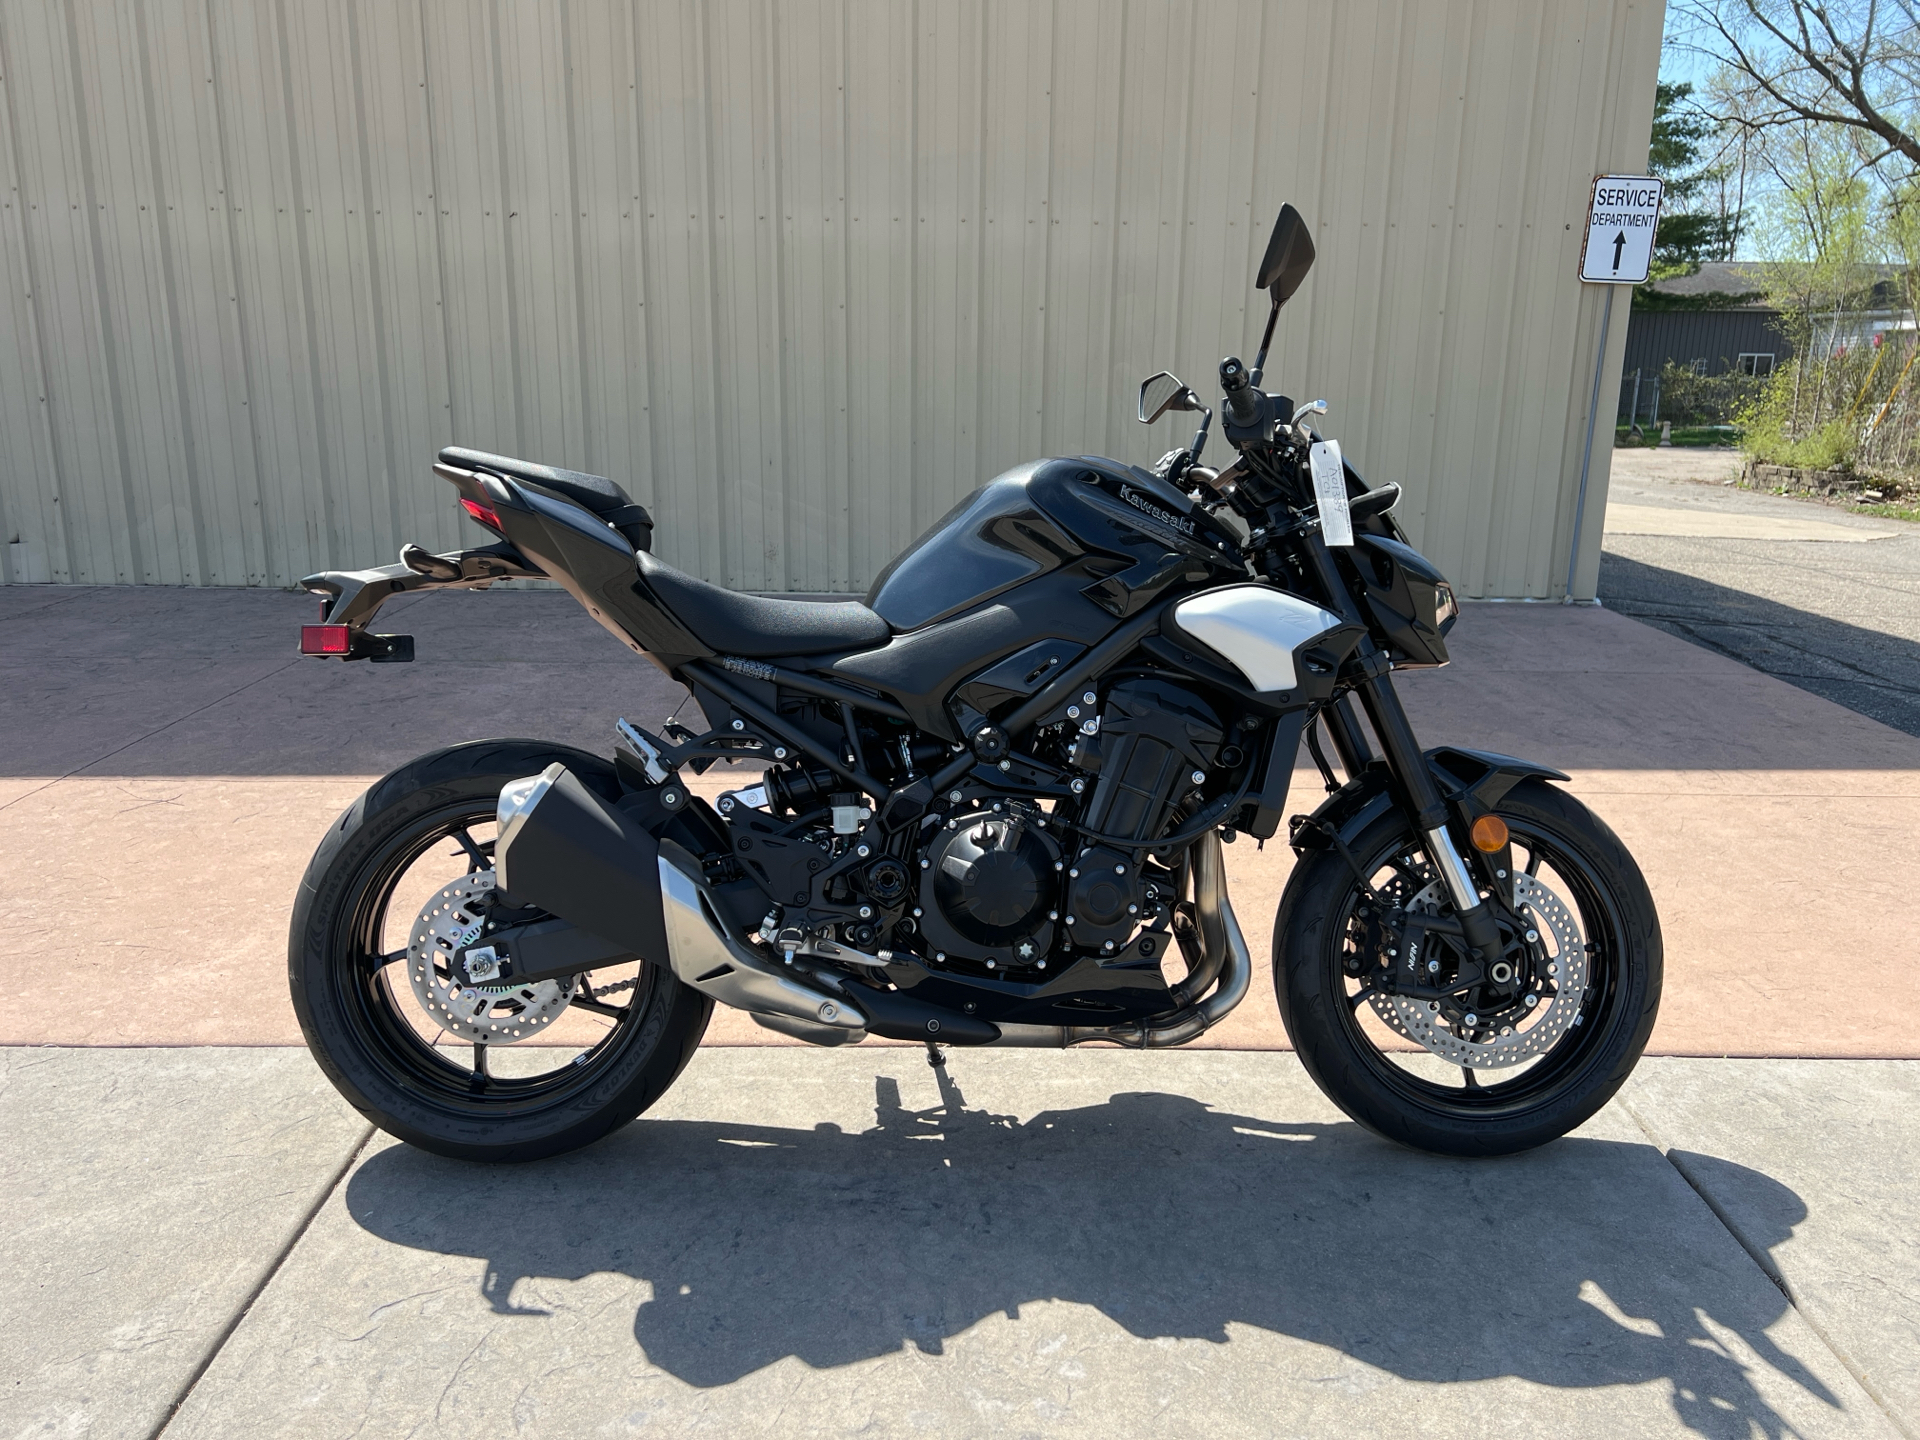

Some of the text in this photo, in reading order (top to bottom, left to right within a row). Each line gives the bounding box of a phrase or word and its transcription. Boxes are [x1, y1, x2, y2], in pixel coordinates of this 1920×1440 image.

[1592, 213, 1655, 228] DEPARTMENT
[1597, 188, 1657, 207] SERVICE
[1120, 483, 1196, 536] Kawasaki
[317, 840, 367, 927] SPORTMAX
[306, 1018, 337, 1072] DUNLOP
[602, 1039, 648, 1096] DUNLOP
